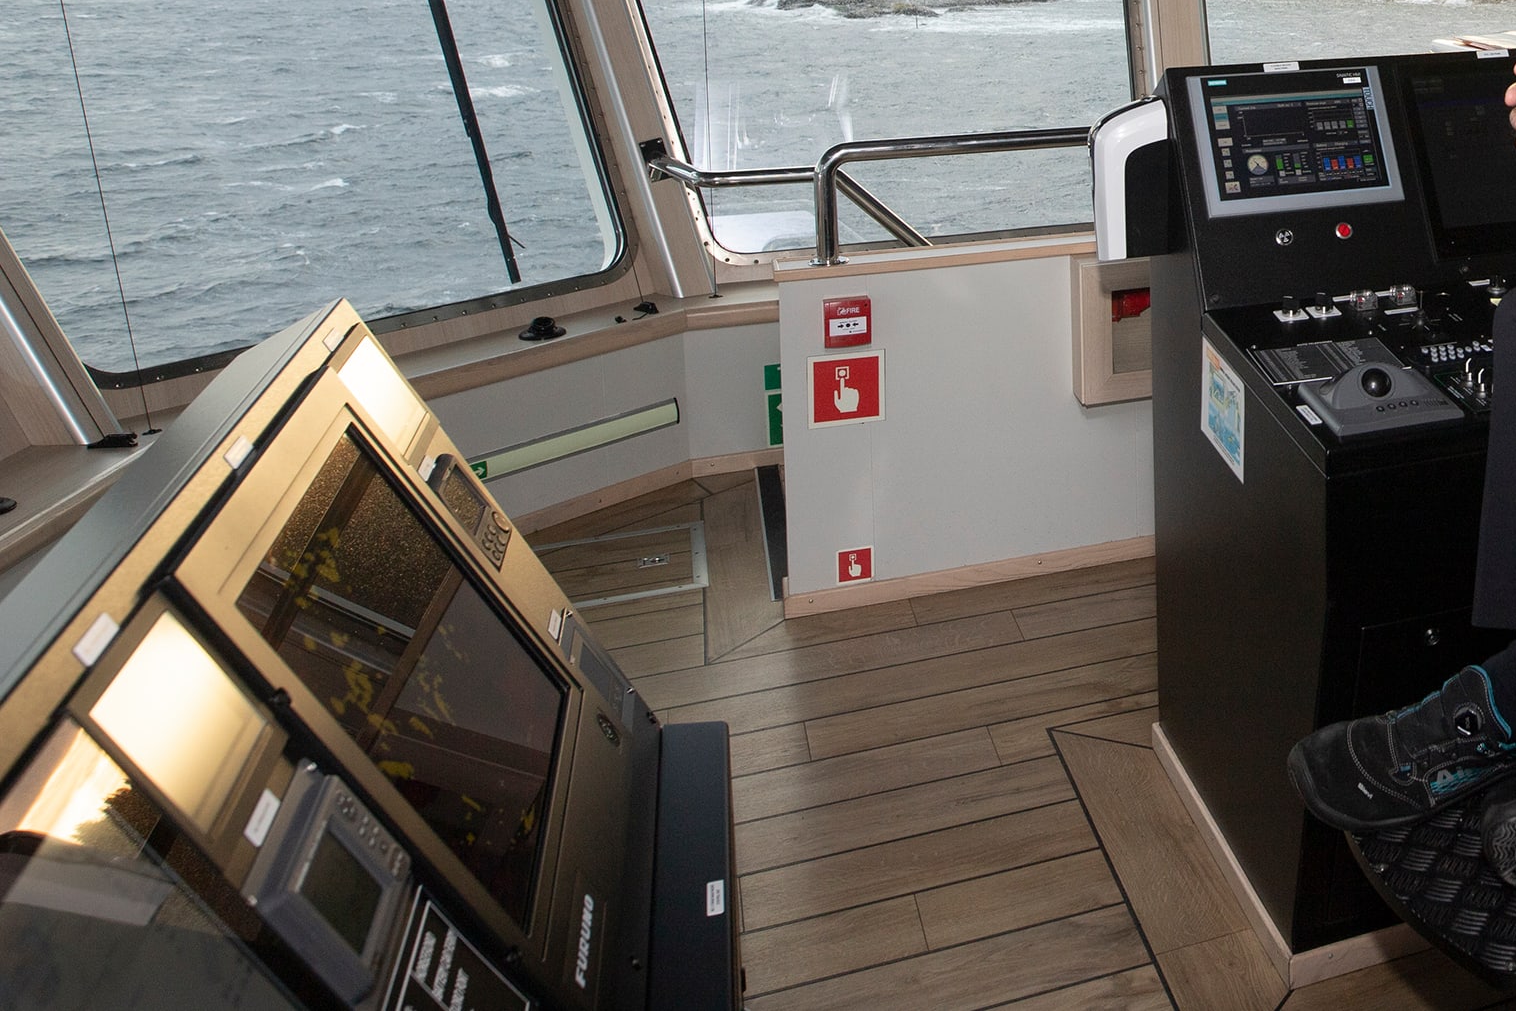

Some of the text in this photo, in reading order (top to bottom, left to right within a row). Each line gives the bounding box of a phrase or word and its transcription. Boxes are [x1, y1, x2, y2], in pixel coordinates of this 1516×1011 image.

[1363, 88, 1375, 110] TOUCH
[846, 306, 861, 315] FIRE
[575, 894, 594, 988] FURUNO
